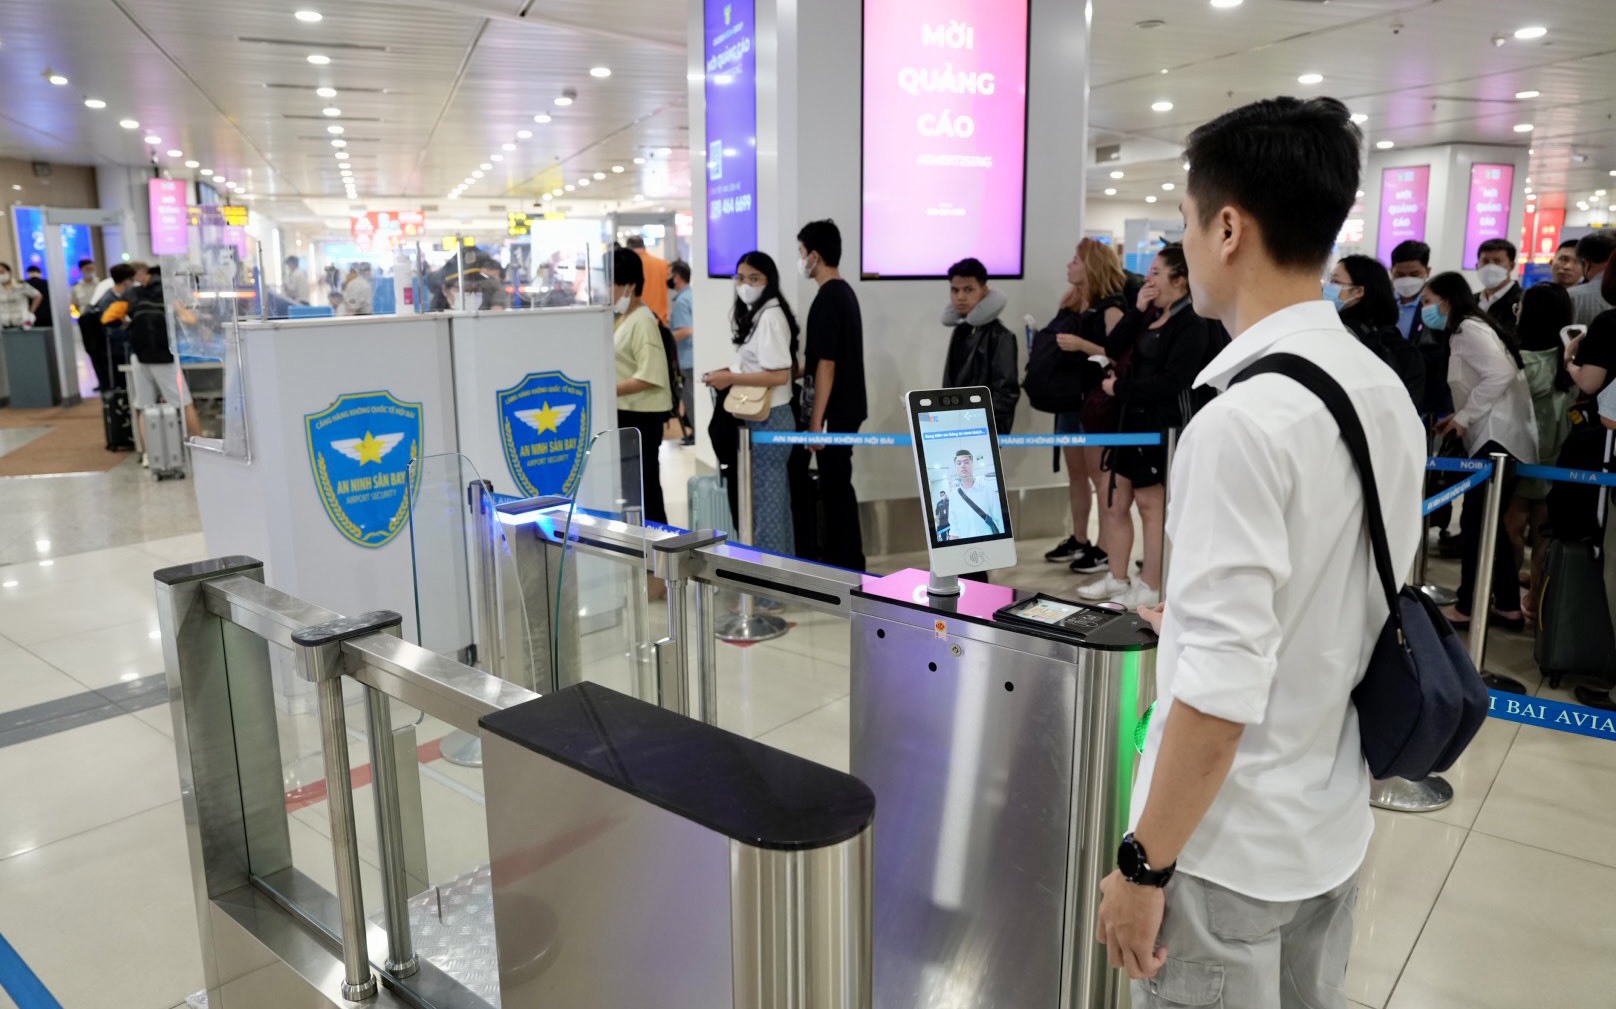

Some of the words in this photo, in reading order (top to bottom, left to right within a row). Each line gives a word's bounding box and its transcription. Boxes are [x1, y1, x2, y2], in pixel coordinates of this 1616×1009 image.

[922, 19, 974, 49] MỜI
[898, 62, 995, 95] QUẢNG
[917, 108, 975, 138] CÁO
[520, 444, 530, 456] AN
[531, 442, 548, 456] NINH
[549, 437, 563, 453] SÂN
[564, 438, 577, 450] BAY
[787, 435, 807, 443] NINH
[808, 435, 832, 443] HÀNG
[834, 435, 863, 444] KHÔNG
[864, 435, 878, 445] NỘI
[1001, 435, 1024, 444] HÀNG
[1026, 435, 1054, 444] KHÔNG
[1056, 436, 1070, 445] NỘI
[337, 480, 349, 494] AN
[350, 476, 372, 492] NINH
[373, 472, 390, 488] SÂN
[390, 470, 407, 487] BAY
[346, 493, 370, 504] AIRPORT
[371, 488, 397, 501] SECURITY
[1506, 699, 1547, 720] BAI
[1555, 710, 1616, 733] AVIA
